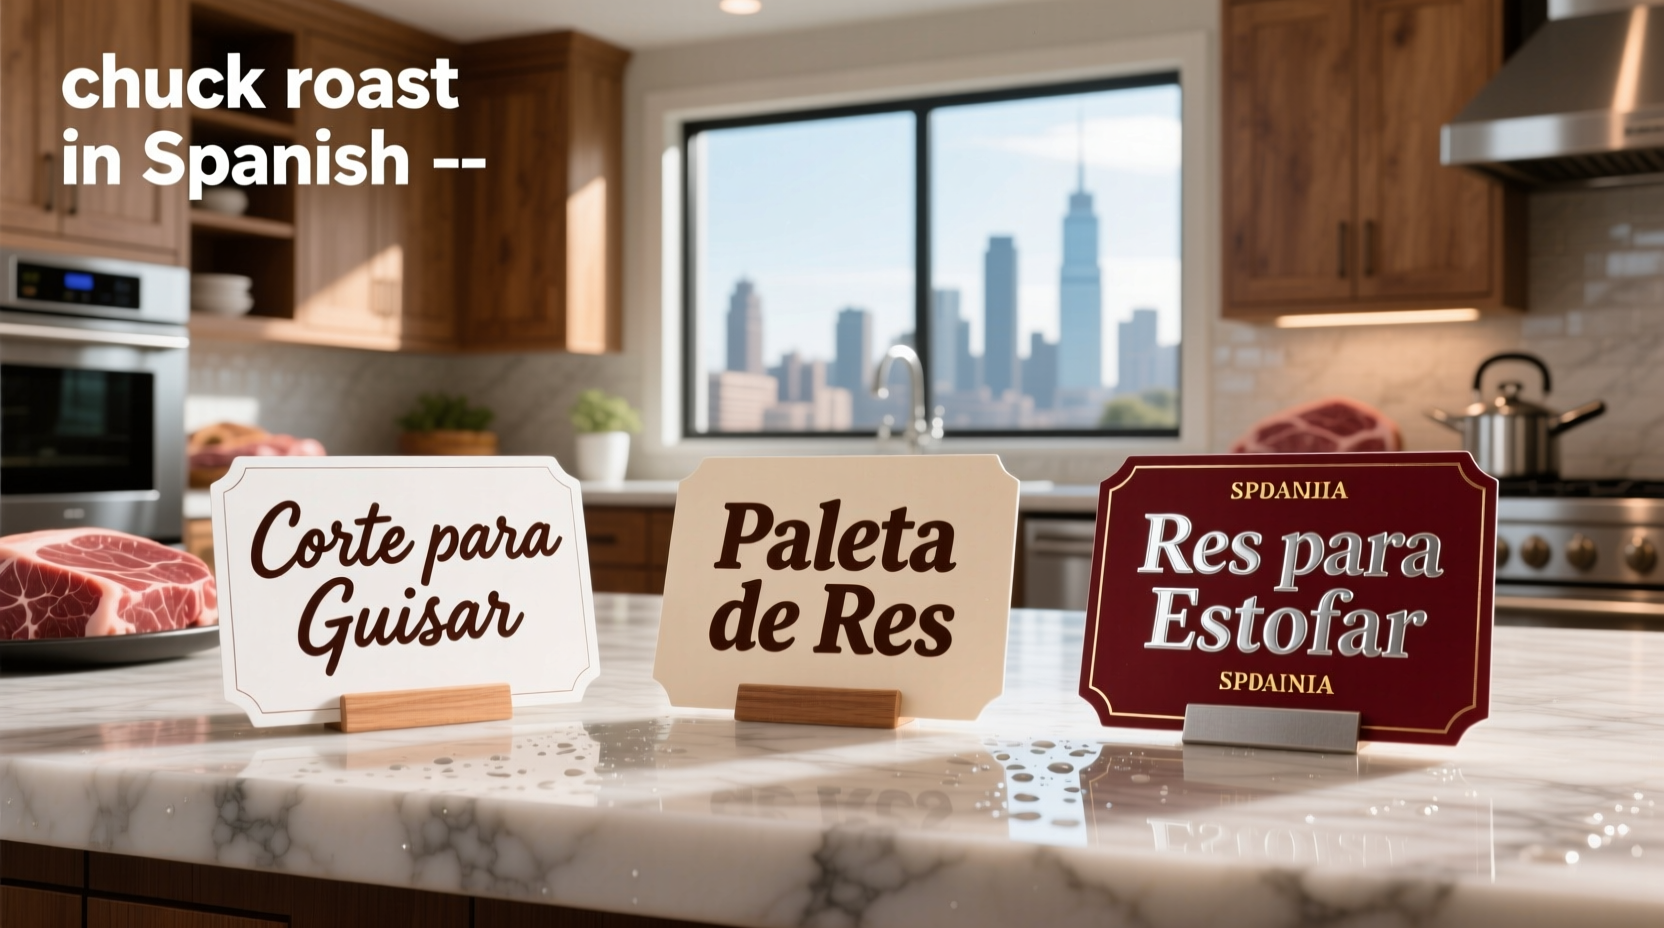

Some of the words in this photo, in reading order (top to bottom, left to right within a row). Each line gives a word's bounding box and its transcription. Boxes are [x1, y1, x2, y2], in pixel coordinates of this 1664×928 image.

[250, 500, 415, 579] Corte
[420, 515, 563, 587] para
[713, 498, 957, 574] Paleta
[1137, 512, 1263, 576] Res
[1273, 531, 1445, 592] para
[297, 576, 525, 677] Guisar
[708, 578, 800, 653] de
[812, 583, 955, 658] Res
[1143, 586, 1428, 659] Estofar
